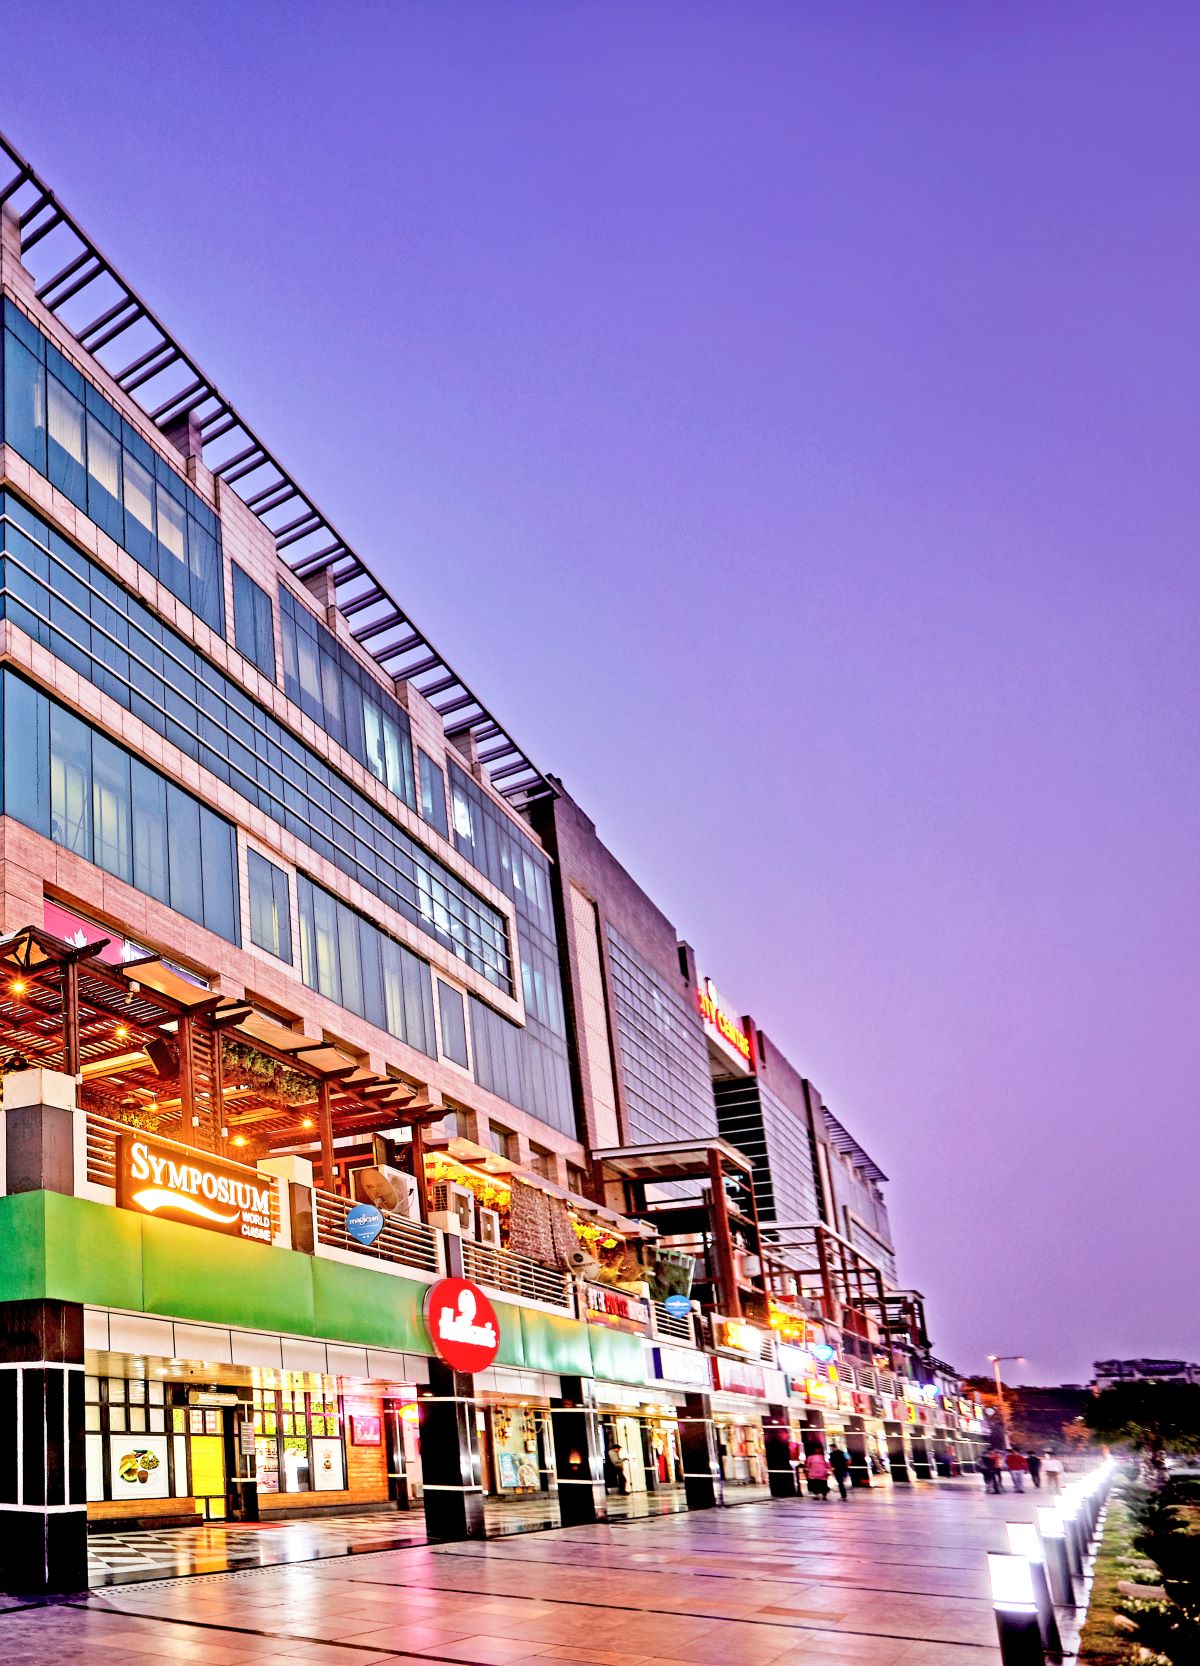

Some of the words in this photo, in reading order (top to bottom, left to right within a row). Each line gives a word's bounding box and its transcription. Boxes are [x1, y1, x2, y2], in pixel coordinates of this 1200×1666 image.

[131, 1142, 270, 1215] SYMPOSIUM
[242, 1211, 270, 1228] WORLD
[241, 1224, 272, 1241] CUISINE
